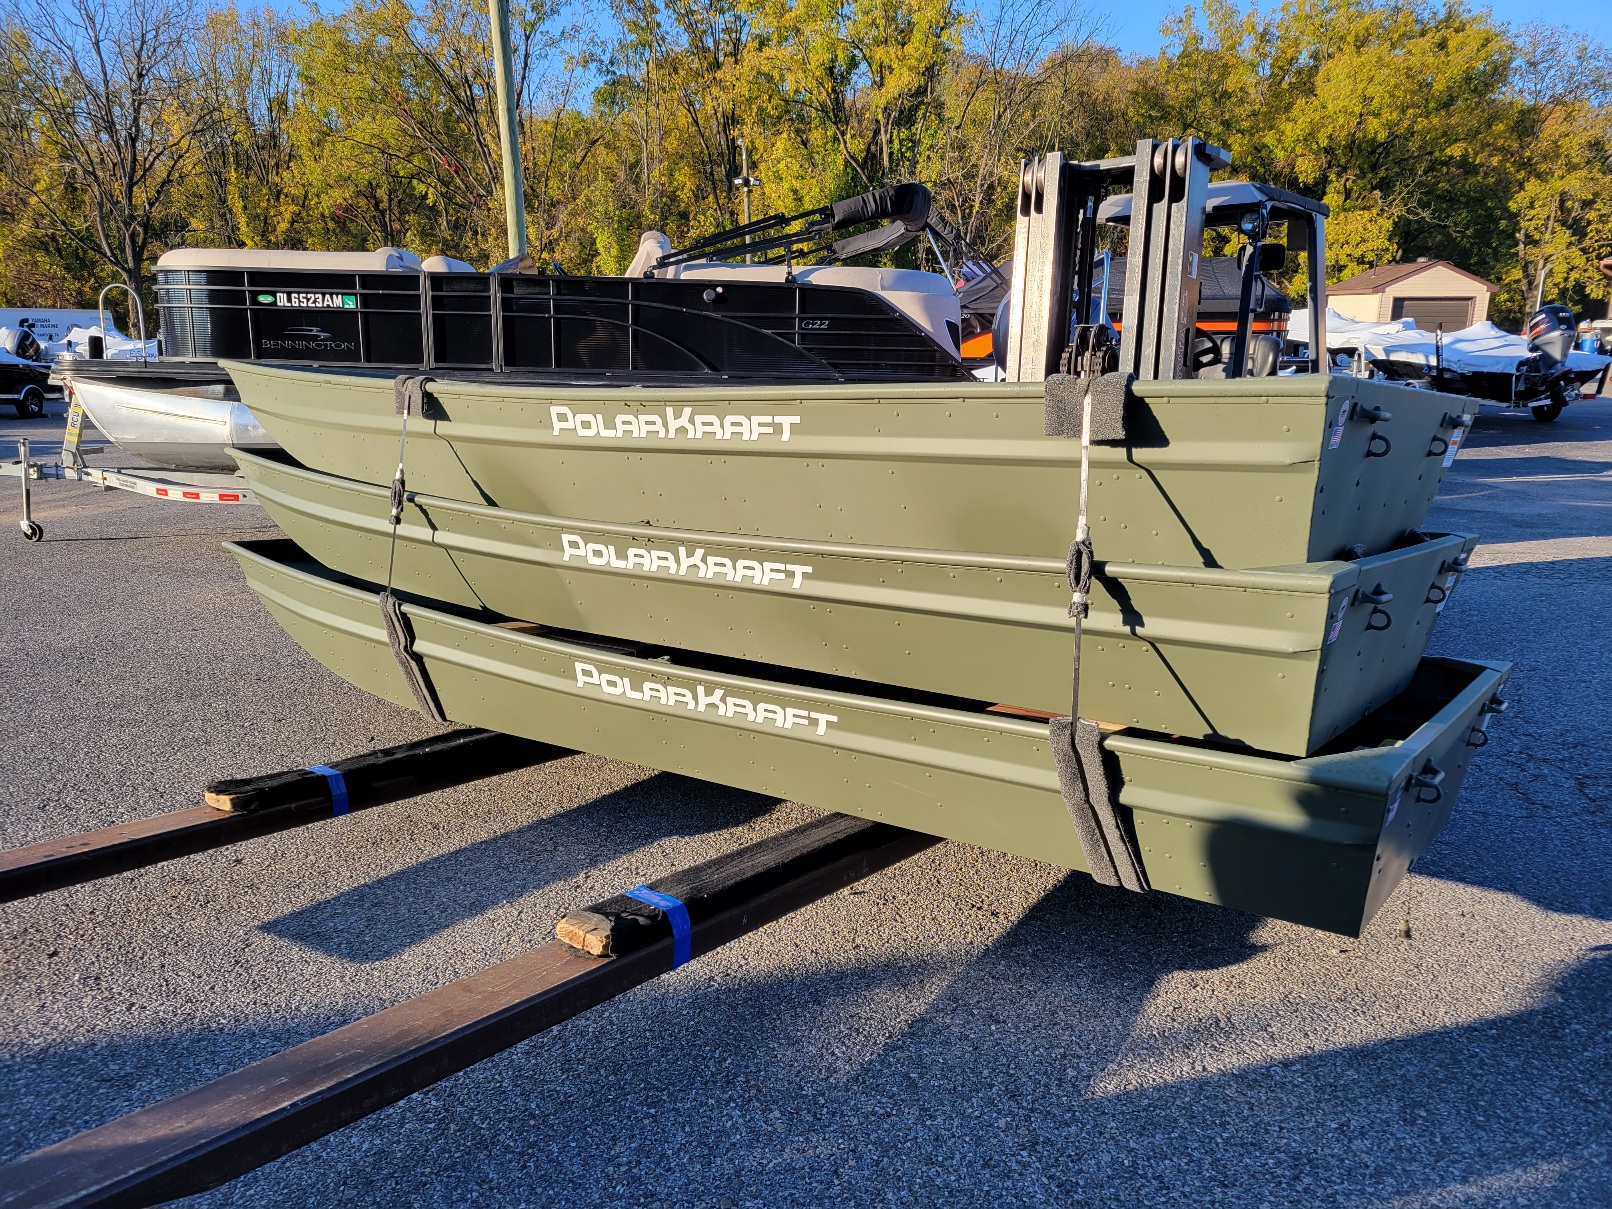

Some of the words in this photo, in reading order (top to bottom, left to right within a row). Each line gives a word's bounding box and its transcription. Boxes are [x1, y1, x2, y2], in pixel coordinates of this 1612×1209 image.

[802, 319, 829, 329] G22
[262, 340, 354, 350] BENNINGTON
[550, 406, 800, 441] POLARKRAFT
[561, 534, 812, 589] POLARKRAFT
[574, 662, 838, 736] POLARKRAFT
